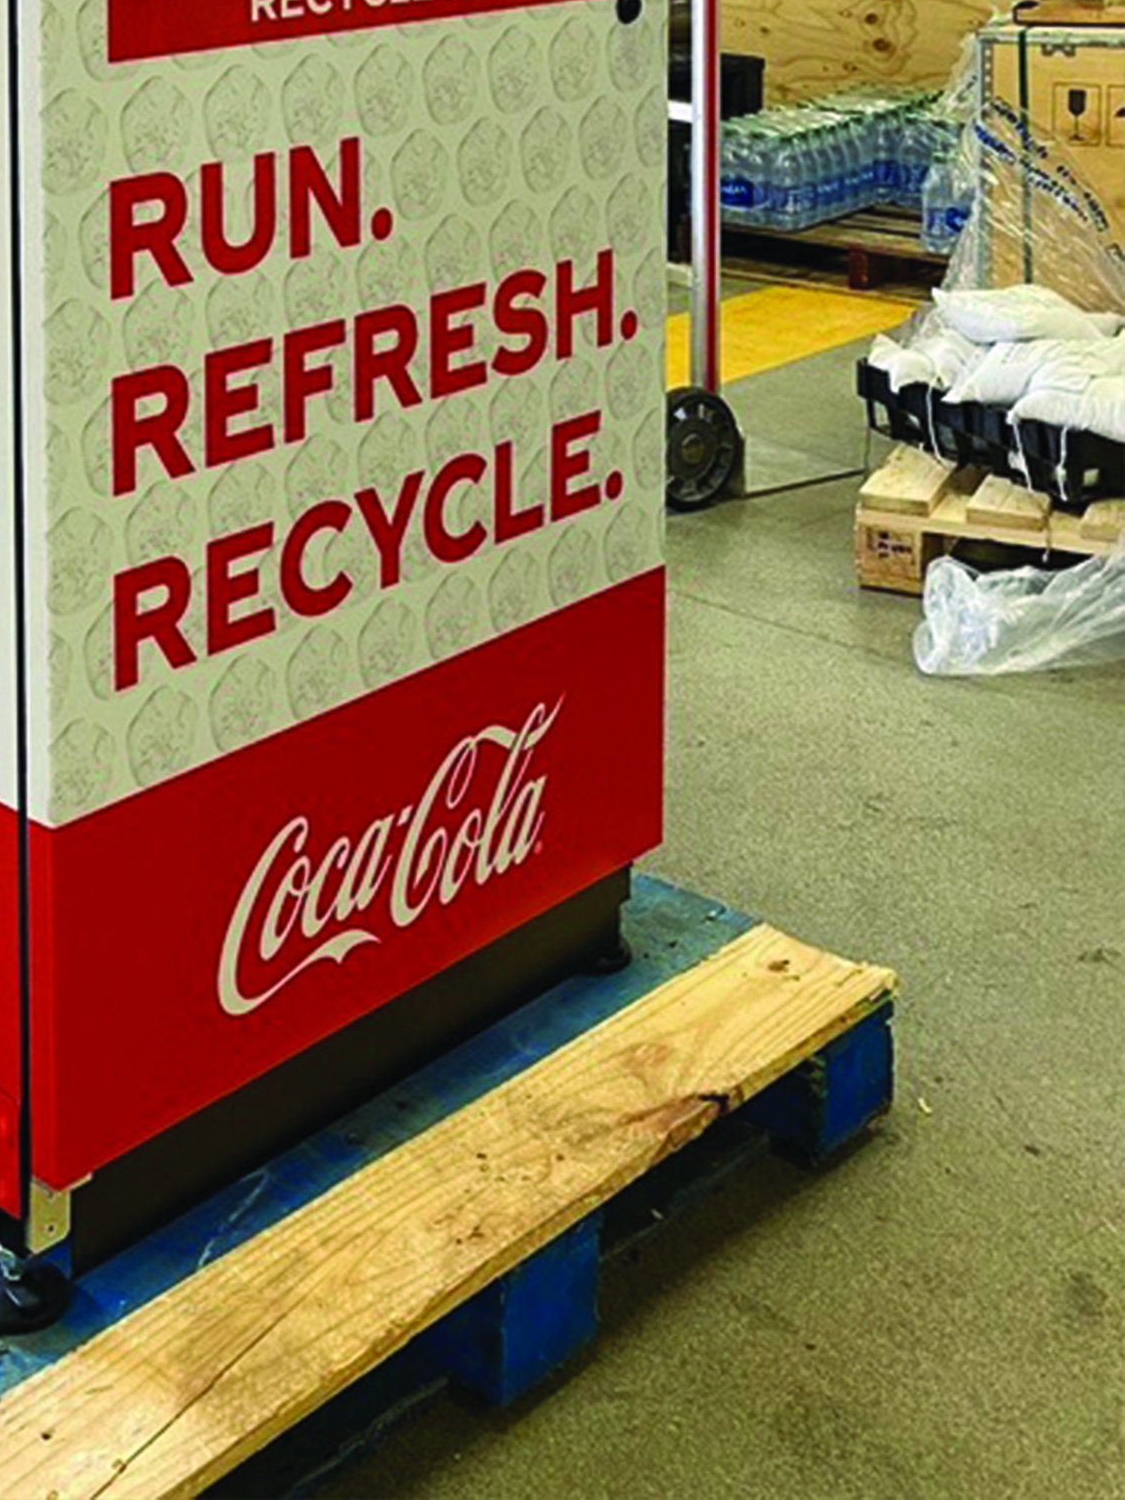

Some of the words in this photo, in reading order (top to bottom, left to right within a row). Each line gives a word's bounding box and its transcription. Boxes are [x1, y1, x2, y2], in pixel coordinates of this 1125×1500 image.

[109, 136, 394, 301] RUN.
[111, 248, 638, 497] REFRESH.
[113, 409, 624, 693] RECYCLE.
[218, 691, 565, 1016] Coca-Cola
